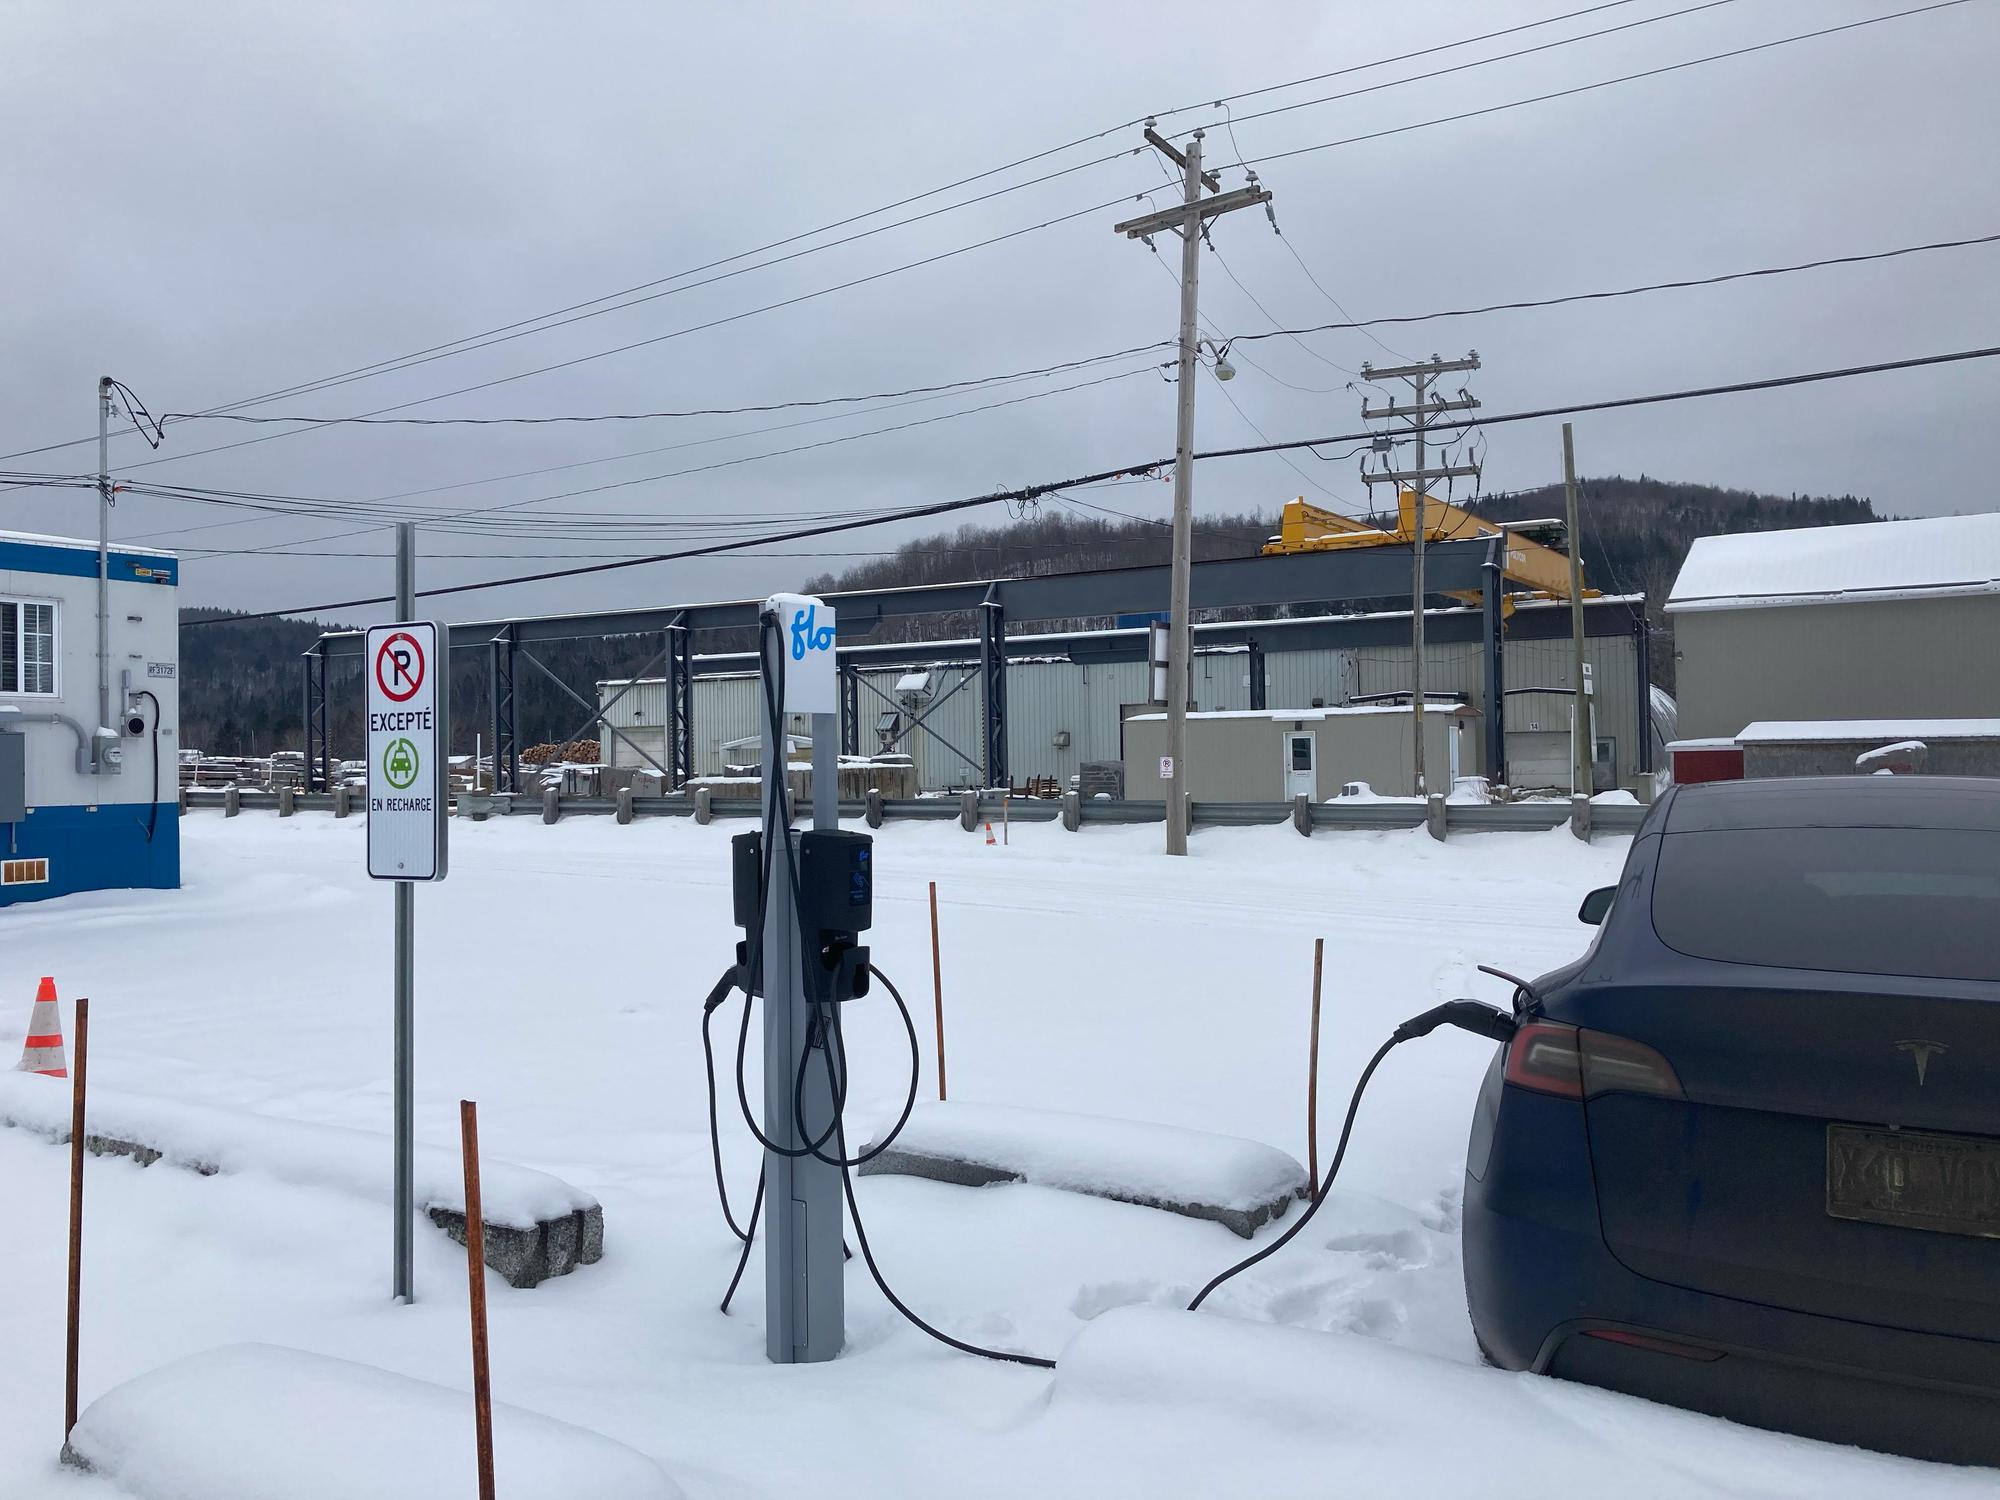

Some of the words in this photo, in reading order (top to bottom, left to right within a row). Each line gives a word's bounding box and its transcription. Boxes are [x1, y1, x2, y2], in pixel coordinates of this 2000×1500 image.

[791, 604, 836, 660] flo
[371, 707, 432, 731] EXCEPTÉ
[372, 799, 383, 811] EN
[387, 798, 432, 811] RECHARGE
